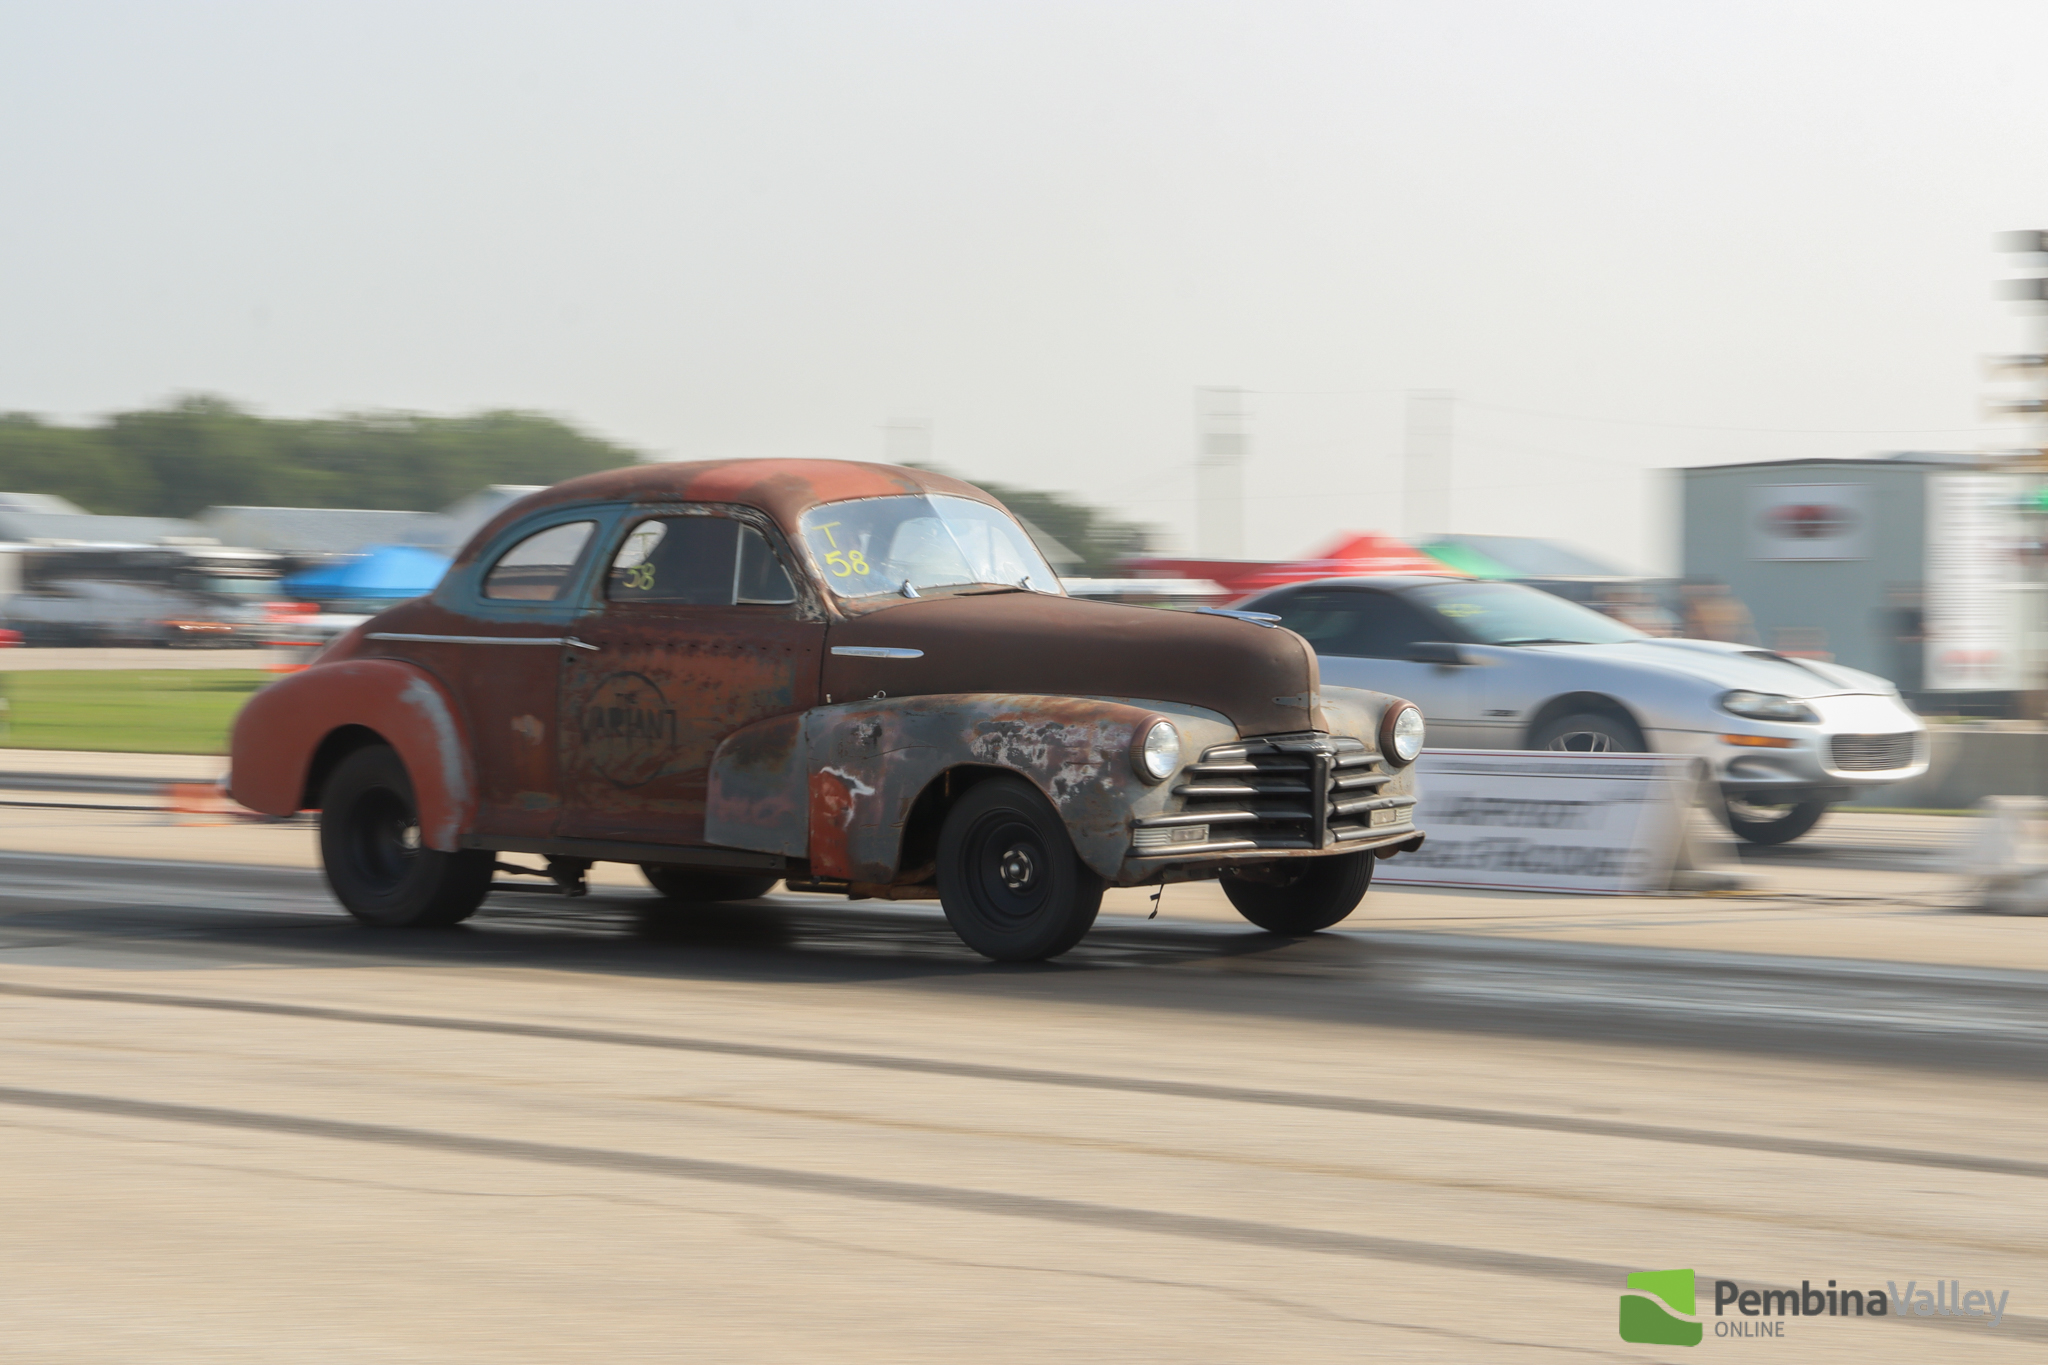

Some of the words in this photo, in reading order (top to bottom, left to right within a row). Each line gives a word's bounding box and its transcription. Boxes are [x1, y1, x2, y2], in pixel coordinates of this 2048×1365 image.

[812, 521, 841, 548] T
[622, 562, 656, 591] 58
[824, 550, 870, 577] 58
